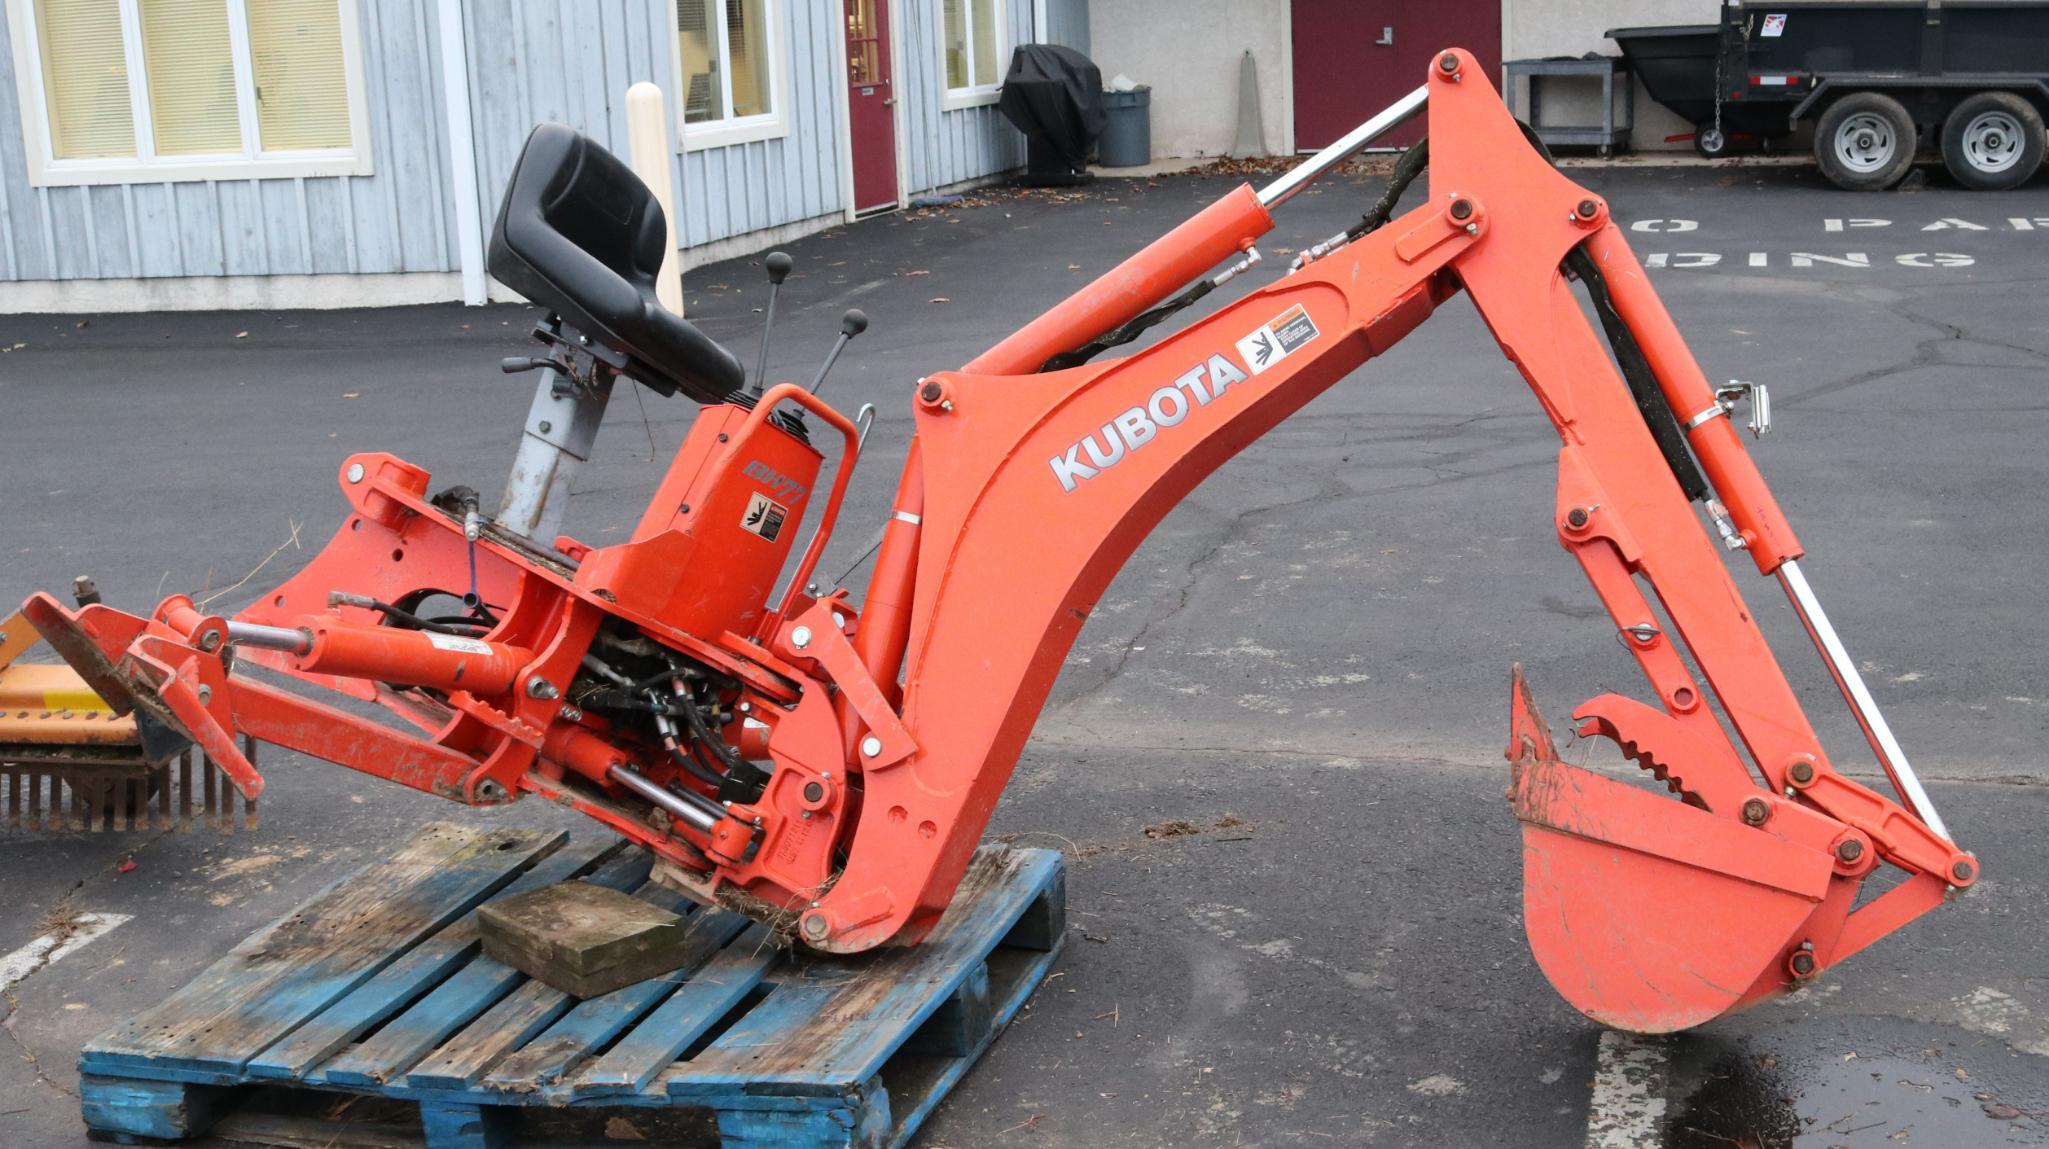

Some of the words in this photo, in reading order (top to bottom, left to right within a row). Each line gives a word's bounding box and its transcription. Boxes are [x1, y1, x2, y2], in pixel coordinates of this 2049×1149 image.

[1645, 252, 1975, 267] DING
[1049, 352, 1249, 493] KUBOTA
[742, 460, 806, 505] BH77
